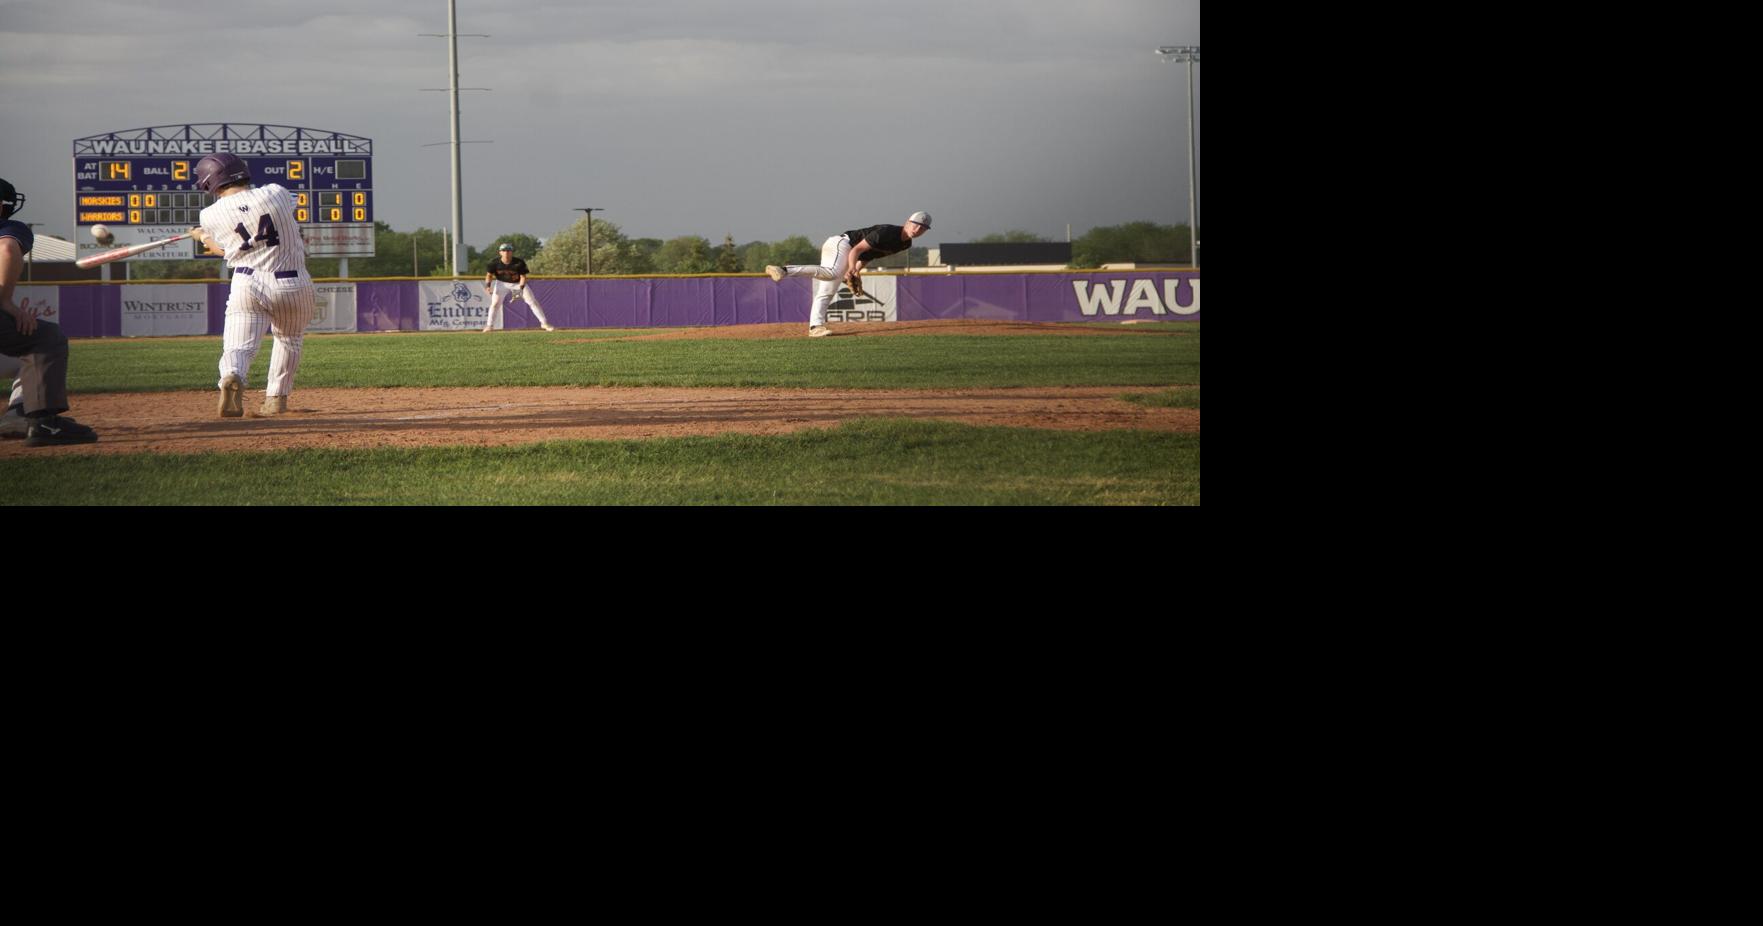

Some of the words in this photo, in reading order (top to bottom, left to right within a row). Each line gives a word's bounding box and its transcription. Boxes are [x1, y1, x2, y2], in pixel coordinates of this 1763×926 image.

[92, 140, 229, 154] WAUNAKEE
[236, 140, 356, 153] BASEBALL
[77, 172, 97, 180] BAT
[110, 162, 129, 179] 14
[143, 167, 169, 175] BALL
[174, 161, 187, 180] 2
[264, 166, 285, 174] OUT
[289, 161, 302, 179] 2
[313, 166, 334, 175] H/E
[130, 194, 140, 207] 0
[145, 194, 156, 207] 0
[354, 193, 363, 206] 0
[81, 212, 122, 221] WARRIORS
[130, 210, 140, 223] 0
[297, 208, 307, 221] 0
[331, 208, 340, 221] 0
[354, 208, 363, 221] 0
[239, 205, 249, 213] W
[234, 213, 280, 251] 14
[1072, 278, 1200, 315] WAU
[124, 300, 204, 311] WINTRUST
